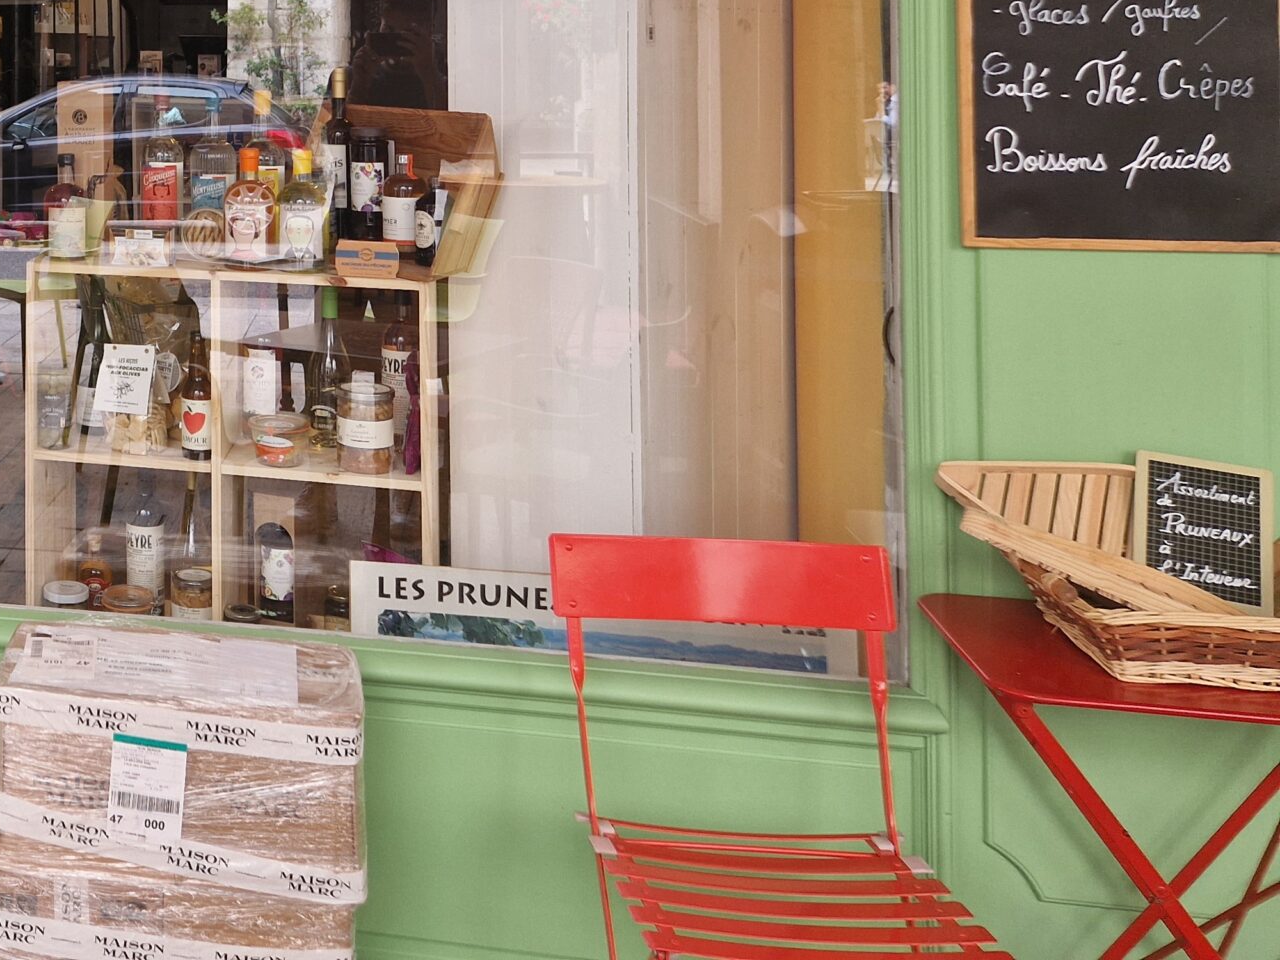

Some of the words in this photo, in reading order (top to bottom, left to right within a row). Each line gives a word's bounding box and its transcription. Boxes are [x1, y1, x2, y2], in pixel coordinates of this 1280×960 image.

[981, 51, 1050, 112] Café
[1158, 58, 1254, 111] Crêpes
[985, 126, 1108, 173] Boissons
[1120, 133, 1232, 189] fraîches
[1154, 471, 1256, 505] Assortiment
[1156, 494, 1176, 507] de
[1158, 512, 1254, 547] PRUNEAUX
[1158, 540, 1173, 554] à
[377, 575, 425, 601] LES
[437, 581, 556, 611] PRUNE
[68, 704, 137, 722] MAISON
[76, 716, 128, 732] MARC
[186, 720, 256, 738] MAISON
[195, 732, 247, 748] MARC
[41, 815, 110, 839] MAISON
[110, 814, 124, 824] 47
[144, 818, 165, 831] 000
[49, 828, 100, 848] MARC
[159, 844, 230, 868] MAISON
[167, 855, 219, 877] MARC
[280, 871, 351, 889] MAISON
[288, 882, 342, 899] MARC
[94, 935, 165, 954] MAISON
[103, 947, 155, 960] MARC
